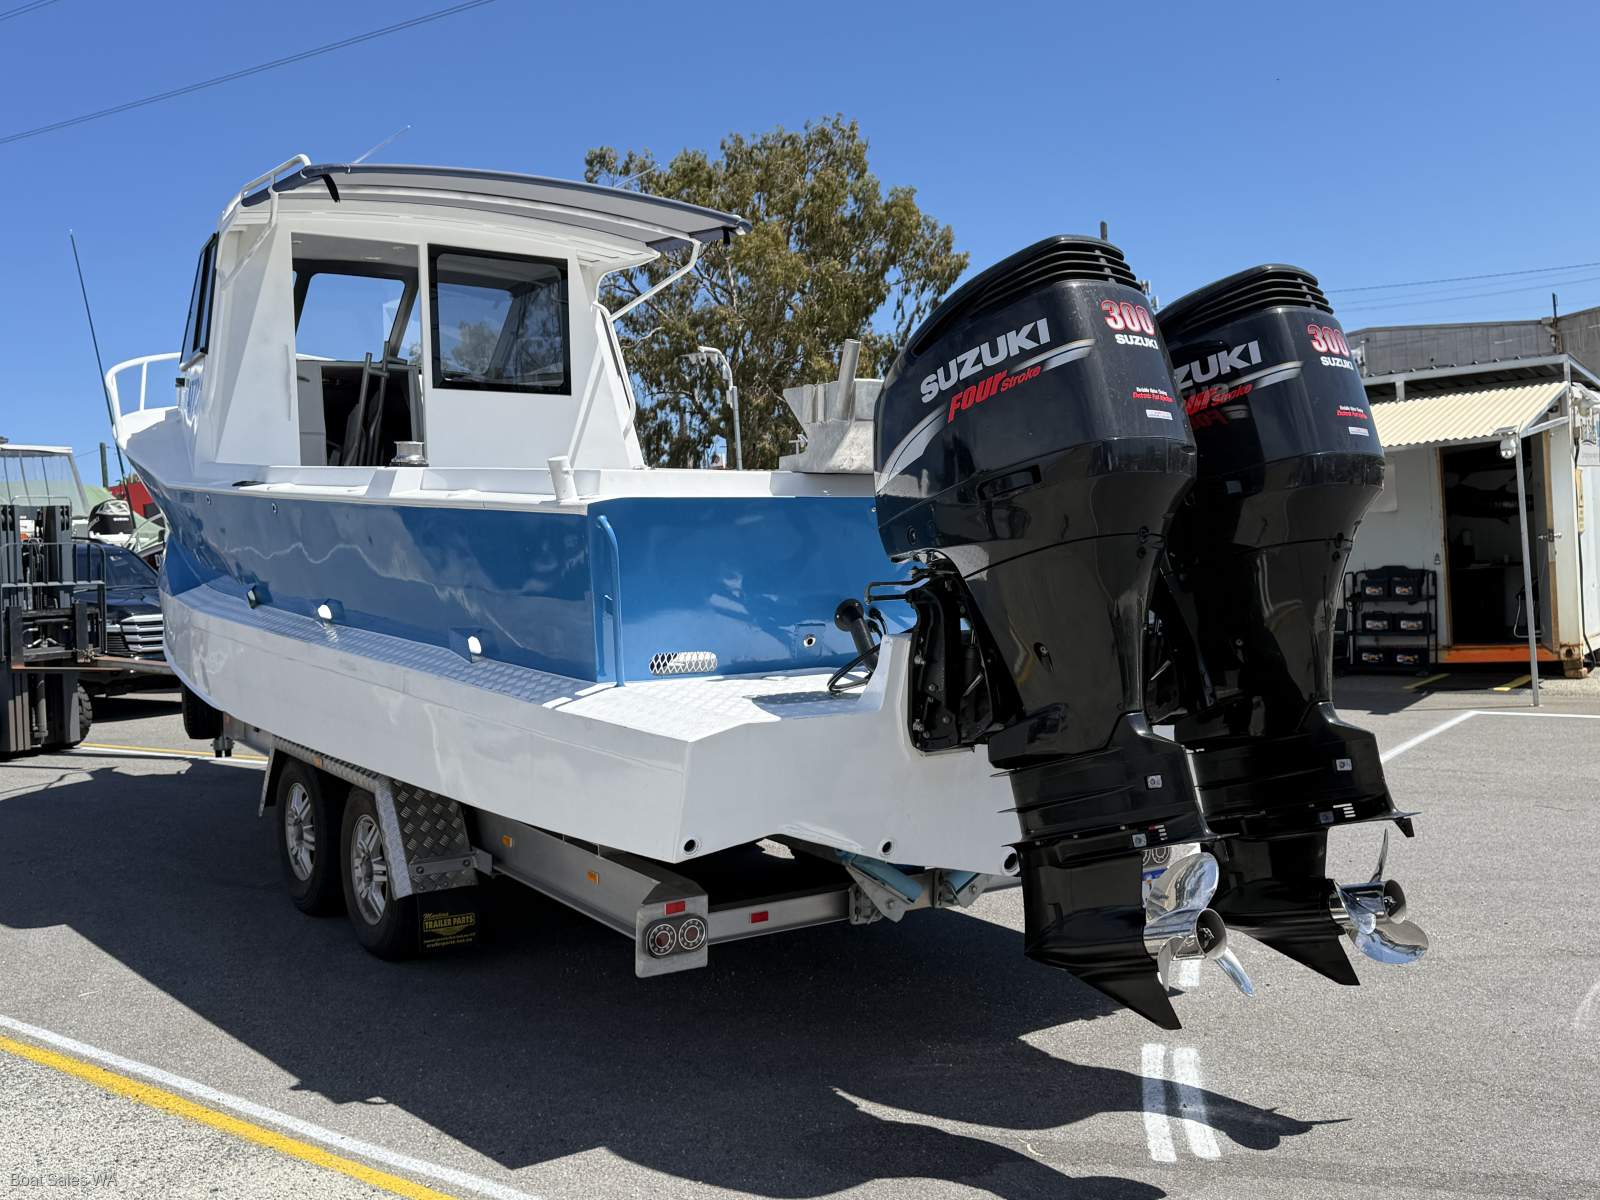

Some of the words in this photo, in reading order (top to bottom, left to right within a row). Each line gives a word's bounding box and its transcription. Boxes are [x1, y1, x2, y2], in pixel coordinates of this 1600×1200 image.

[1101, 300, 1155, 336] 300
[1114, 333, 1159, 350] SUZUKI
[1307, 324, 1350, 358] 300
[920, 317, 1051, 404] SUZUKI
[1174, 340, 1262, 391] ZUKI
[1000, 365, 1041, 393] Stroke
[424, 918, 452, 929] TRAILER
[452, 914, 473, 927] PARTS
